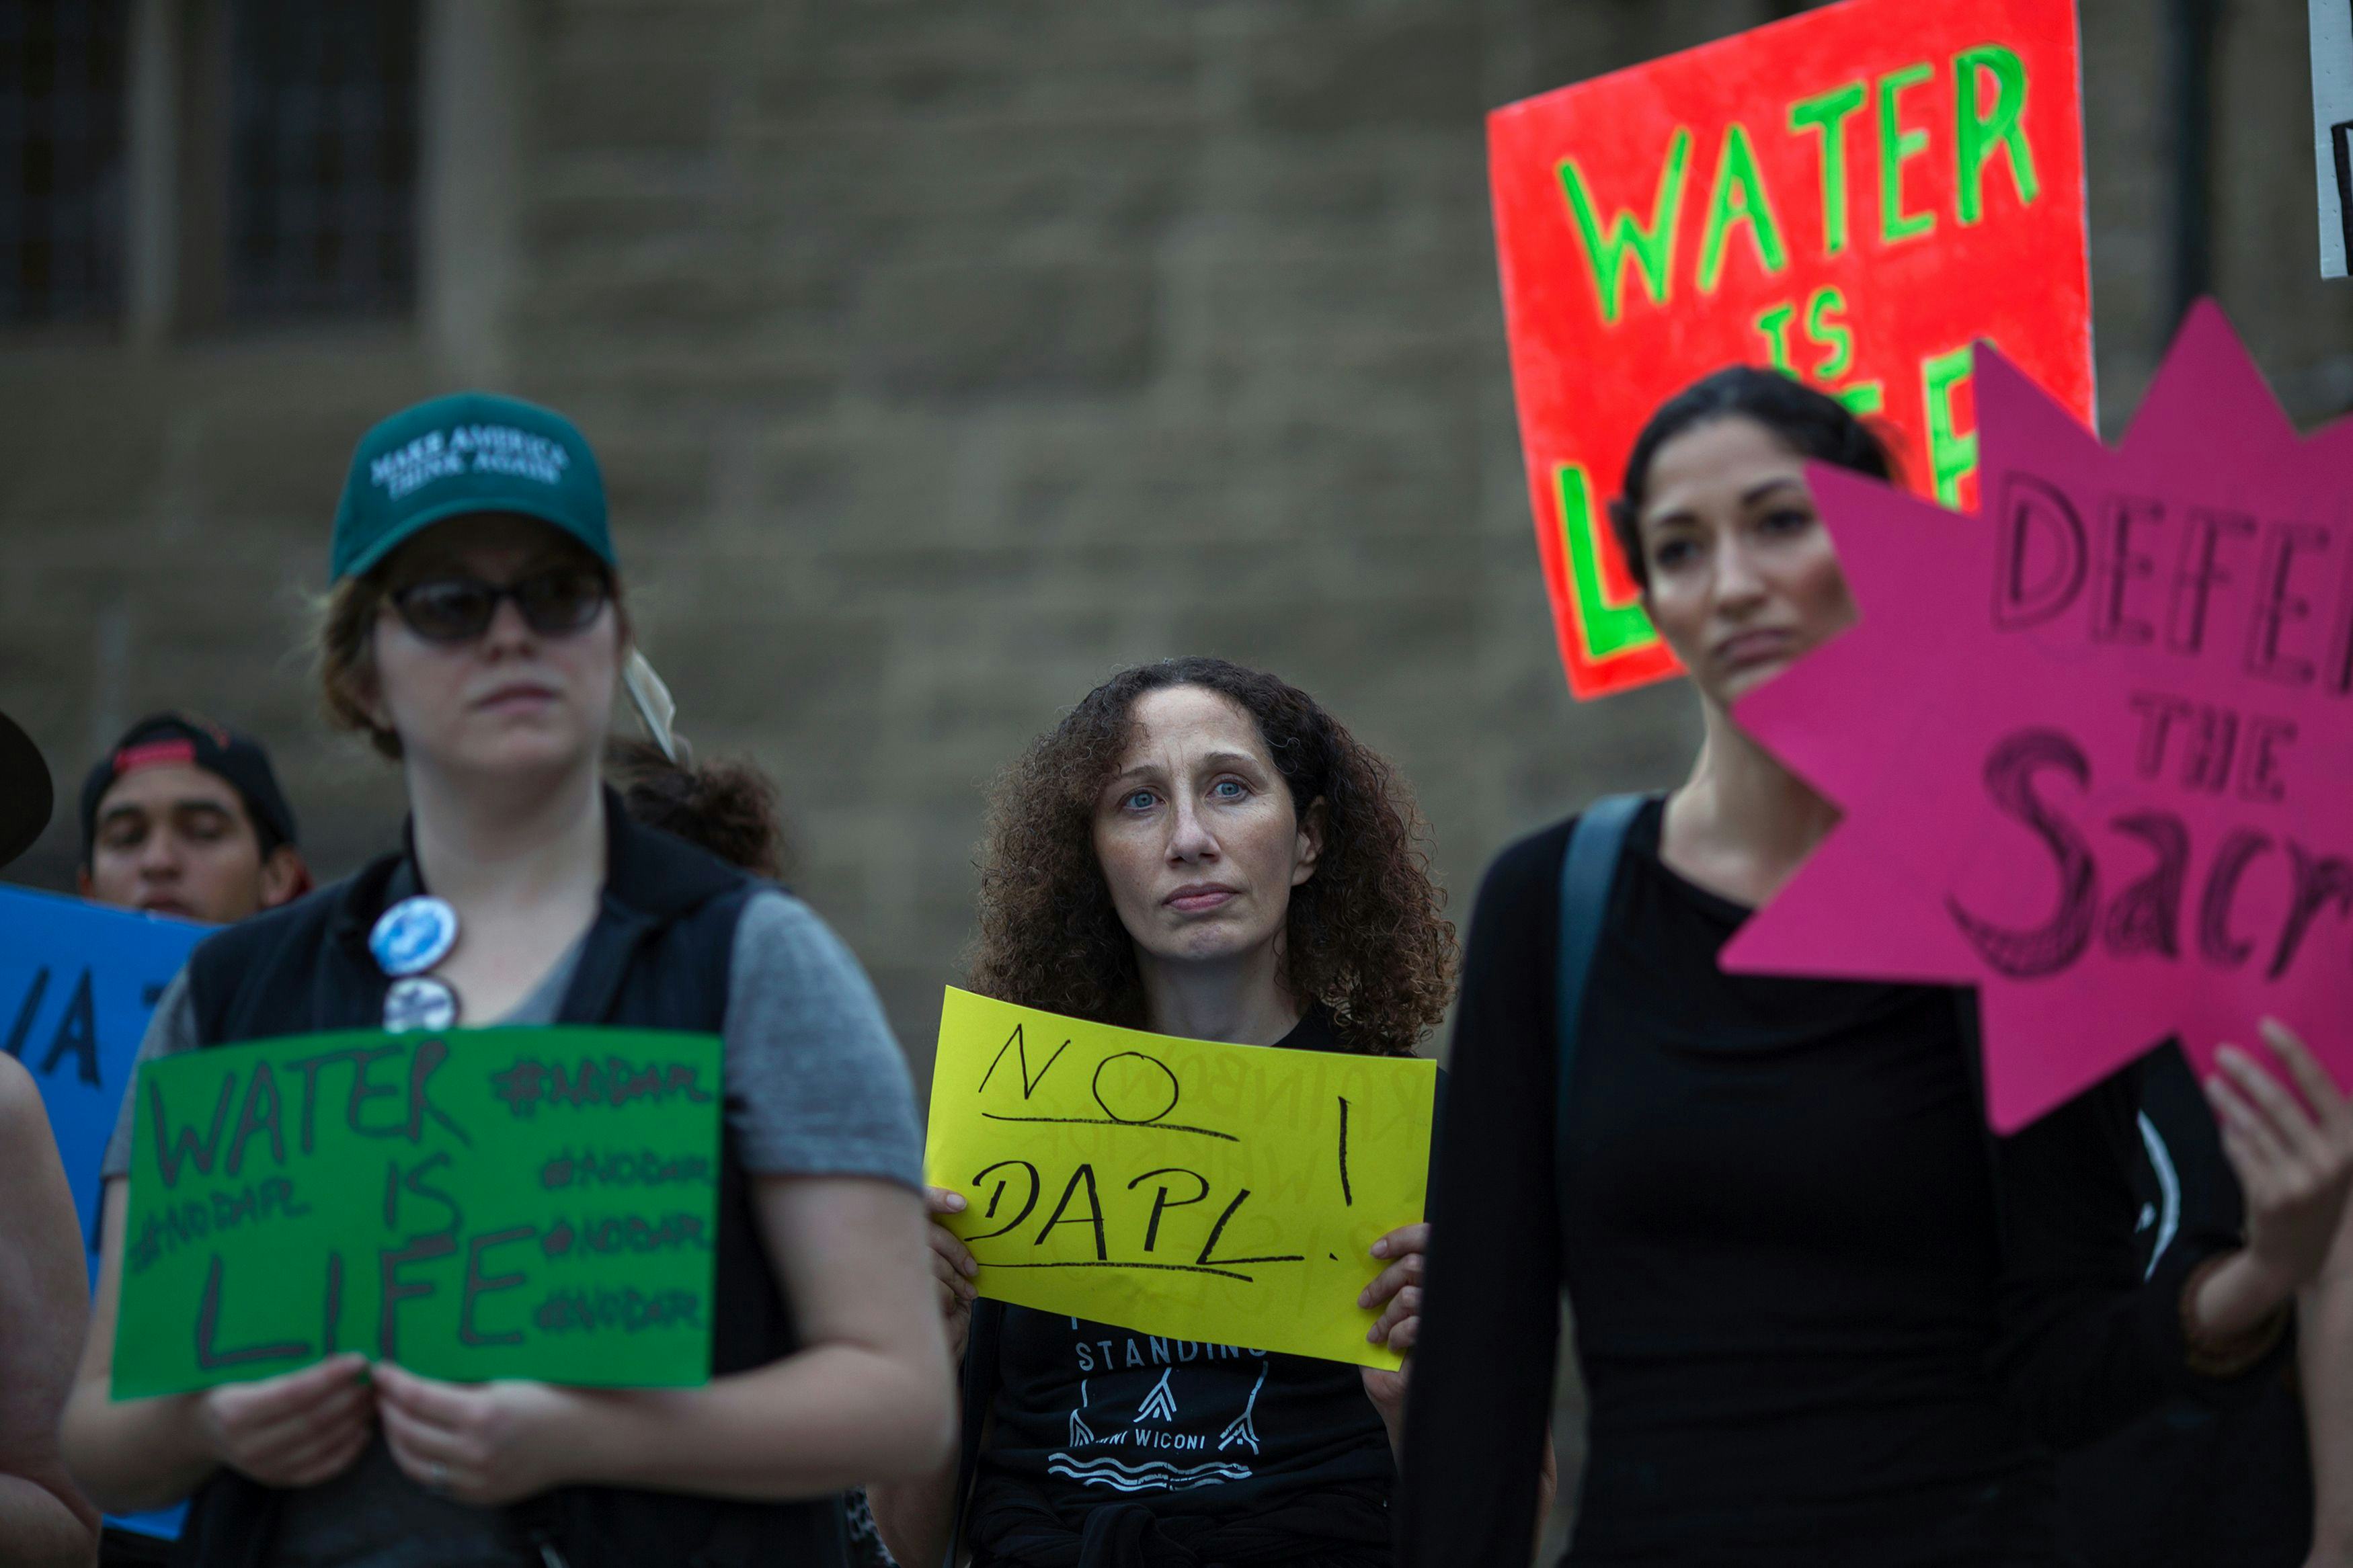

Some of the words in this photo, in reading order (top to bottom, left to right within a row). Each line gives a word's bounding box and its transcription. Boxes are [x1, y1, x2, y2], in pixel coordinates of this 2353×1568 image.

[1554, 42, 2040, 325] WATER
[1756, 286, 1853, 382] IS
[370, 430, 445, 487] MAKE
[449, 423, 569, 470] AMERICA
[2127, 690, 2300, 804] THE
[149, 1039, 475, 1188] WATER
[978, 1023, 1179, 1124] NO
[385, 1151, 464, 1241] IS
[963, 1160, 1305, 1266] DAPL
[197, 1225, 536, 1370] LIFE
[1075, 1335, 1268, 1371] STANDIN
[1135, 1428, 1205, 1449] WICONI
